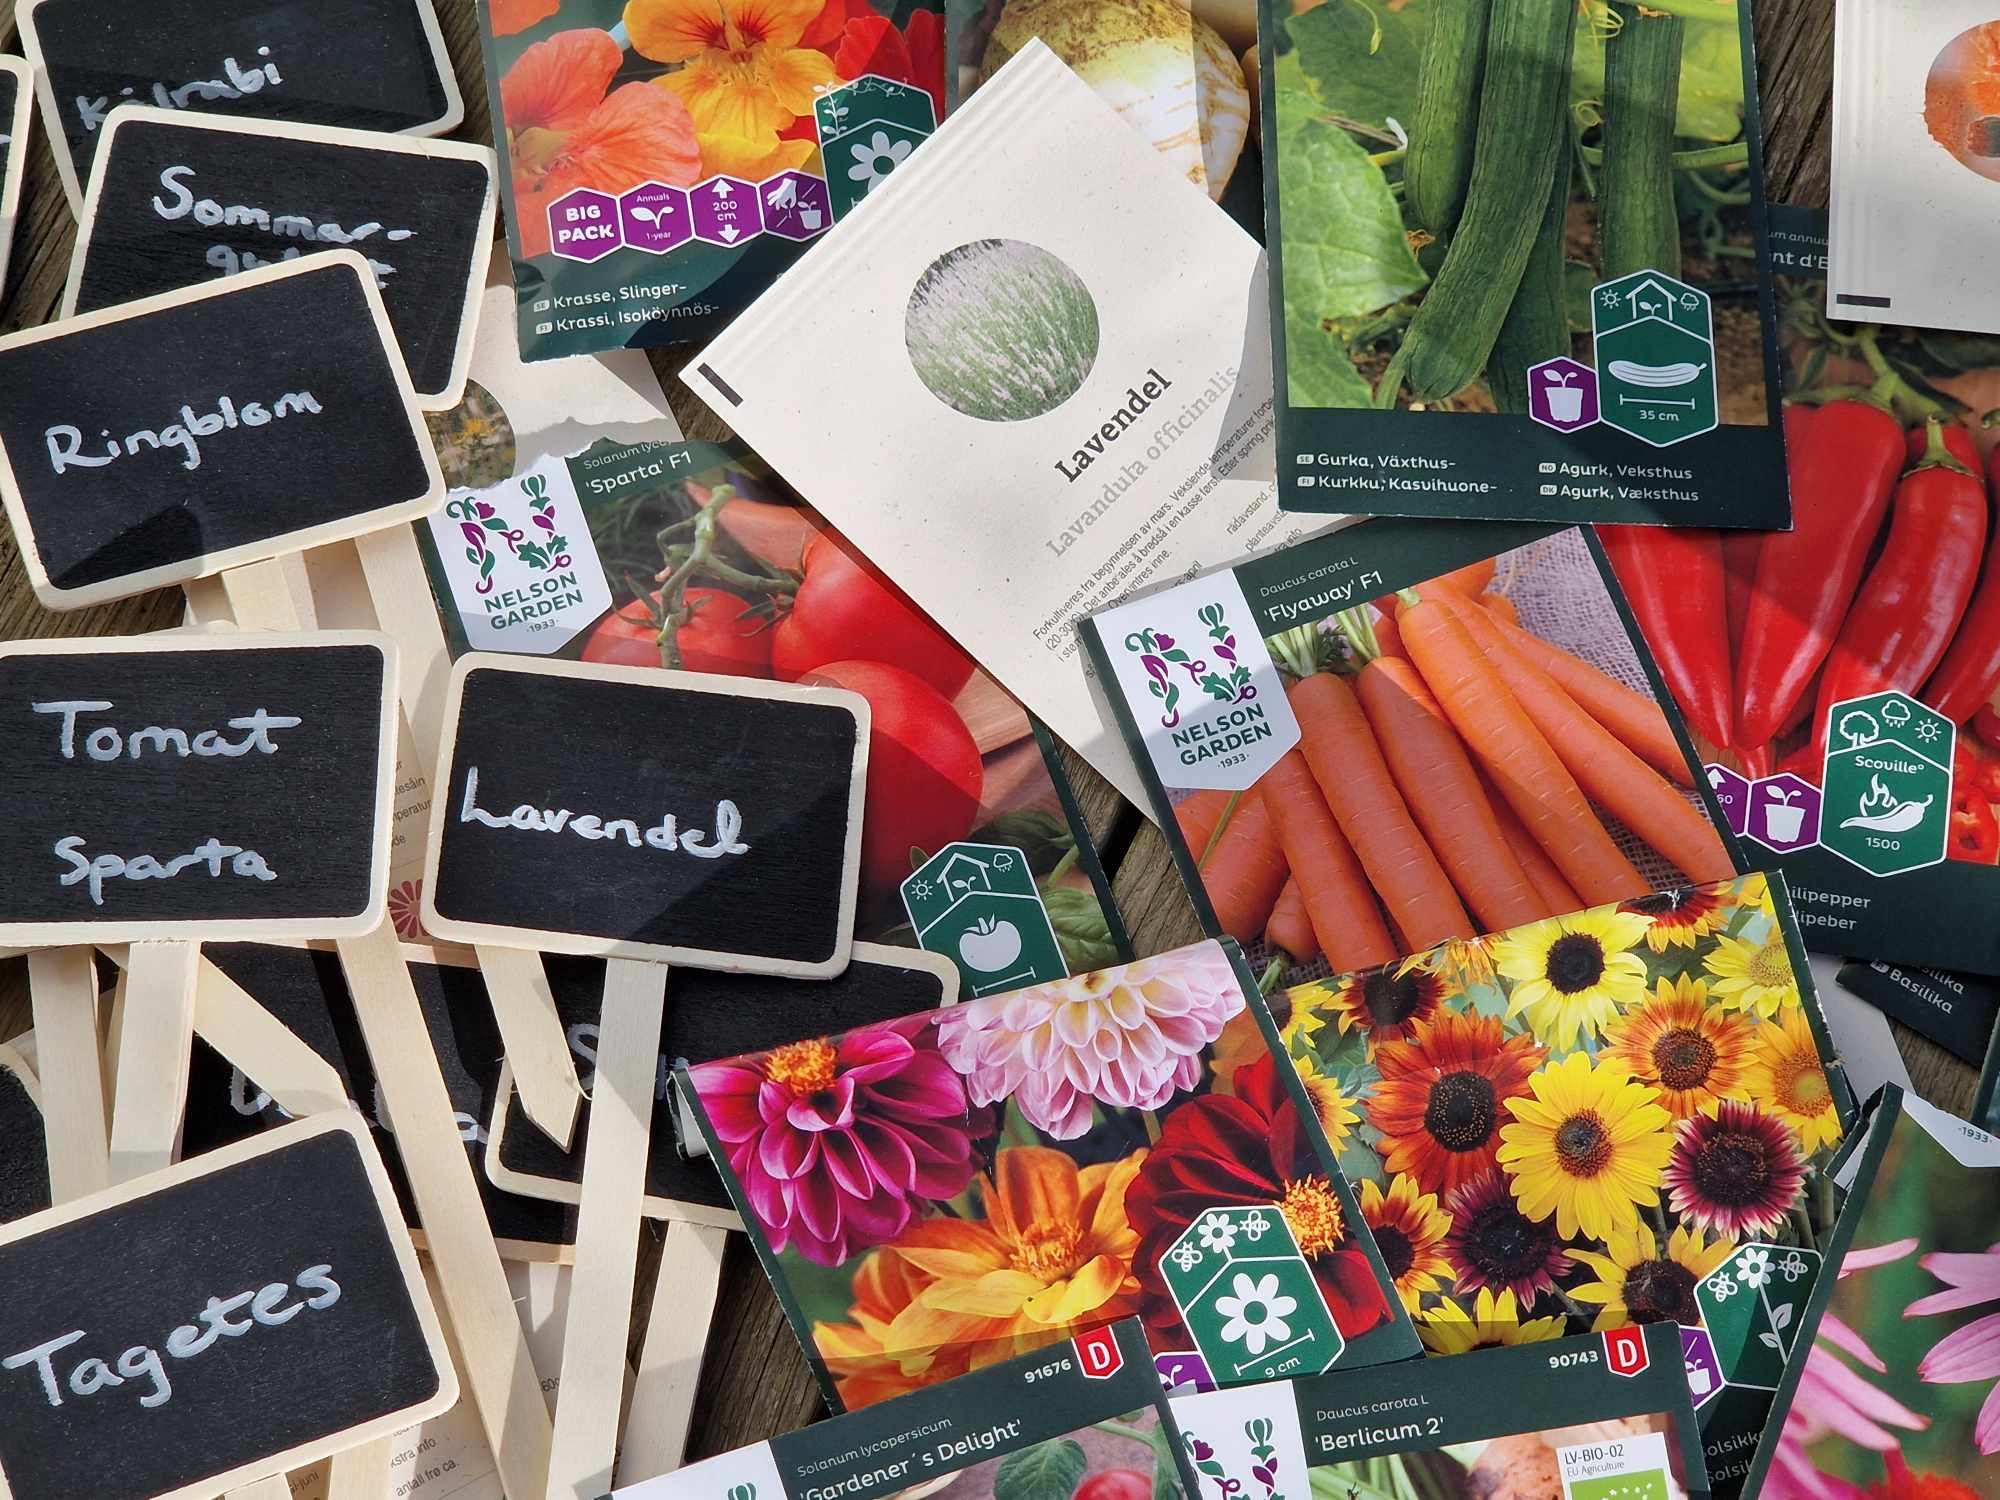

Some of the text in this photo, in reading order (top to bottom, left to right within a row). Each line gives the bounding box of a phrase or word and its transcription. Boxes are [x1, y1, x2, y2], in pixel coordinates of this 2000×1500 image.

[76, 46, 283, 131] Klrabi
[152, 165, 418, 244] Sommar-
[636, 191, 670, 203] Annuals
[712, 200, 738, 212] 200
[565, 204, 602, 222] BIG
[716, 210, 737, 221] cm
[558, 223, 615, 244] PACK
[553, 290, 617, 309] Krasse,
[619, 283, 687, 300] Slinger-
[556, 311, 615, 332] Krassi,
[618, 302, 720, 324] Isoköynnös-
[1053, 368, 1173, 483] Lavendel
[1639, 409, 1680, 422] 35 cm
[45, 391, 322, 474] Ringblom
[583, 447, 640, 470] Solanum
[585, 450, 692, 494] 'Sparta' F1
[1046, 366, 1237, 558] Lavandula officinalis
[1317, 453, 1374, 470] Gurka,
[1377, 455, 1457, 470] Växthus-
[1559, 462, 1613, 478] Agurk,
[1617, 464, 1693, 480] Veksthus
[1388, 477, 1498, 493] Kasvihuone-
[1560, 484, 1614, 500] Agurk,
[1617, 486, 1700, 501] Væksthus
[1168, 513, 1182, 529] en
[1178, 492, 1205, 519] kasse
[1092, 531, 1142, 582] begynnelsen
[1139, 520, 1154, 535] av
[484, 571, 578, 613] NELSON
[1260, 575, 1307, 597] Daucus
[1307, 560, 1349, 580] carota
[1359, 570, 1383, 590] F1
[490, 589, 584, 630] GARDEN
[32, 700, 302, 762] Tomat
[1171, 703, 1265, 748] NELSON
[1180, 721, 1273, 766] GARDEN
[460, 765, 752, 860] Lavendel
[1865, 836, 1901, 851] 1500
[55, 835, 279, 905] Sparta
[1889, 968, 1953, 1014] Basilika
[2, 1264, 342, 1408] Tagetes
[1024, 1341, 1111, 1384] 91676 D
[1264, 1356, 1301, 1378] 9 cm
[1548, 1337, 1638, 1370] 90743 D
[1316, 1404, 1369, 1422] Daucus
[1371, 1396, 1419, 1413] carota
[797, 1416, 953, 1478] Solanum lycopersicum
[936, 1418, 1024, 1462] Delight'
[1314, 1422, 1423, 1452] 'Berlicum
[1704, 1431, 1761, 1457] olsikk
[1564, 1443, 1625, 1465] LV-BIO-02
[1566, 1459, 1625, 1477] EU Agriculture
[395, 1473, 425, 1497] antall
